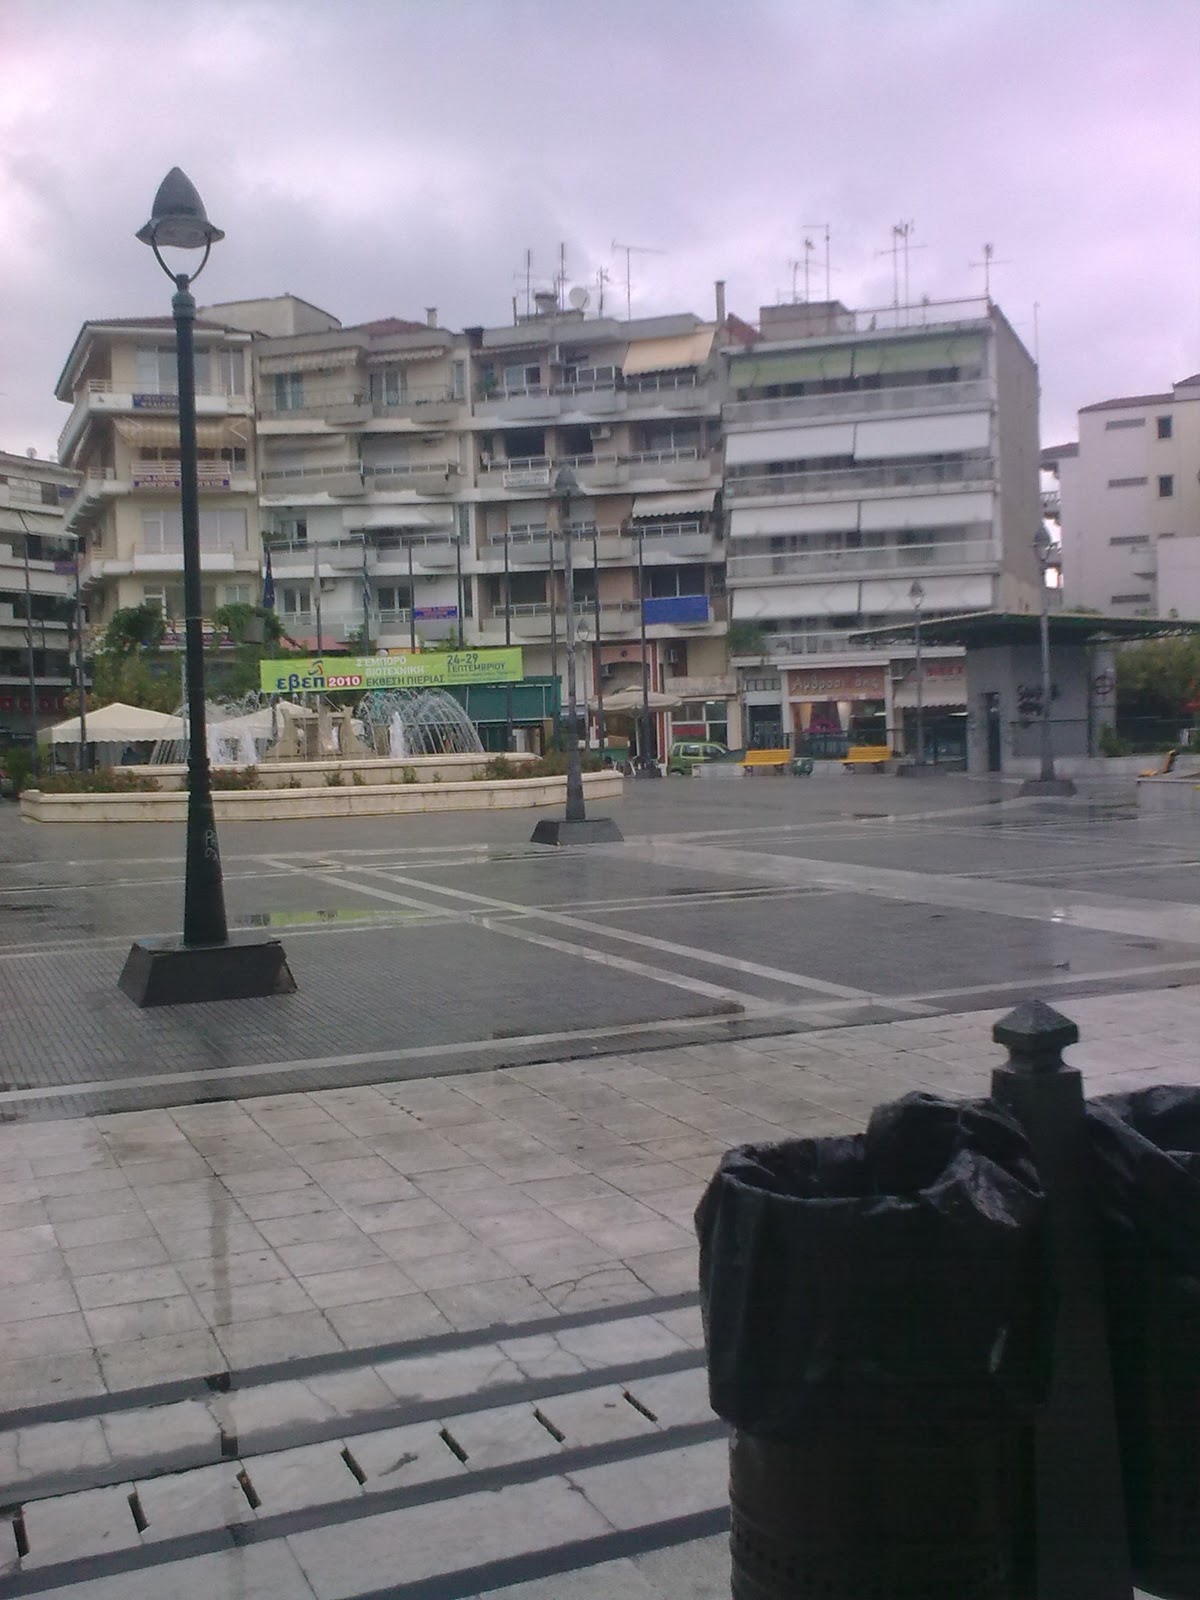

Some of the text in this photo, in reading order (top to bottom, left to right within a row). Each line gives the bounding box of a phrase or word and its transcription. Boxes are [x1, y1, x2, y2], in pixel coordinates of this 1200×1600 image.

[447, 653, 478, 665] 24-29
[365, 665, 424, 677] ΒΙΟΤΕΧΝΙΚΗ
[447, 663, 506, 674] ΣΕΠΤΕΜΒΡΙΟΥ
[328, 676, 361, 687] 2010
[366, 676, 405, 687] ΕΚΘΕΣΗ
[407, 675, 445, 686] ΠΙΕΡΙΑΣ
